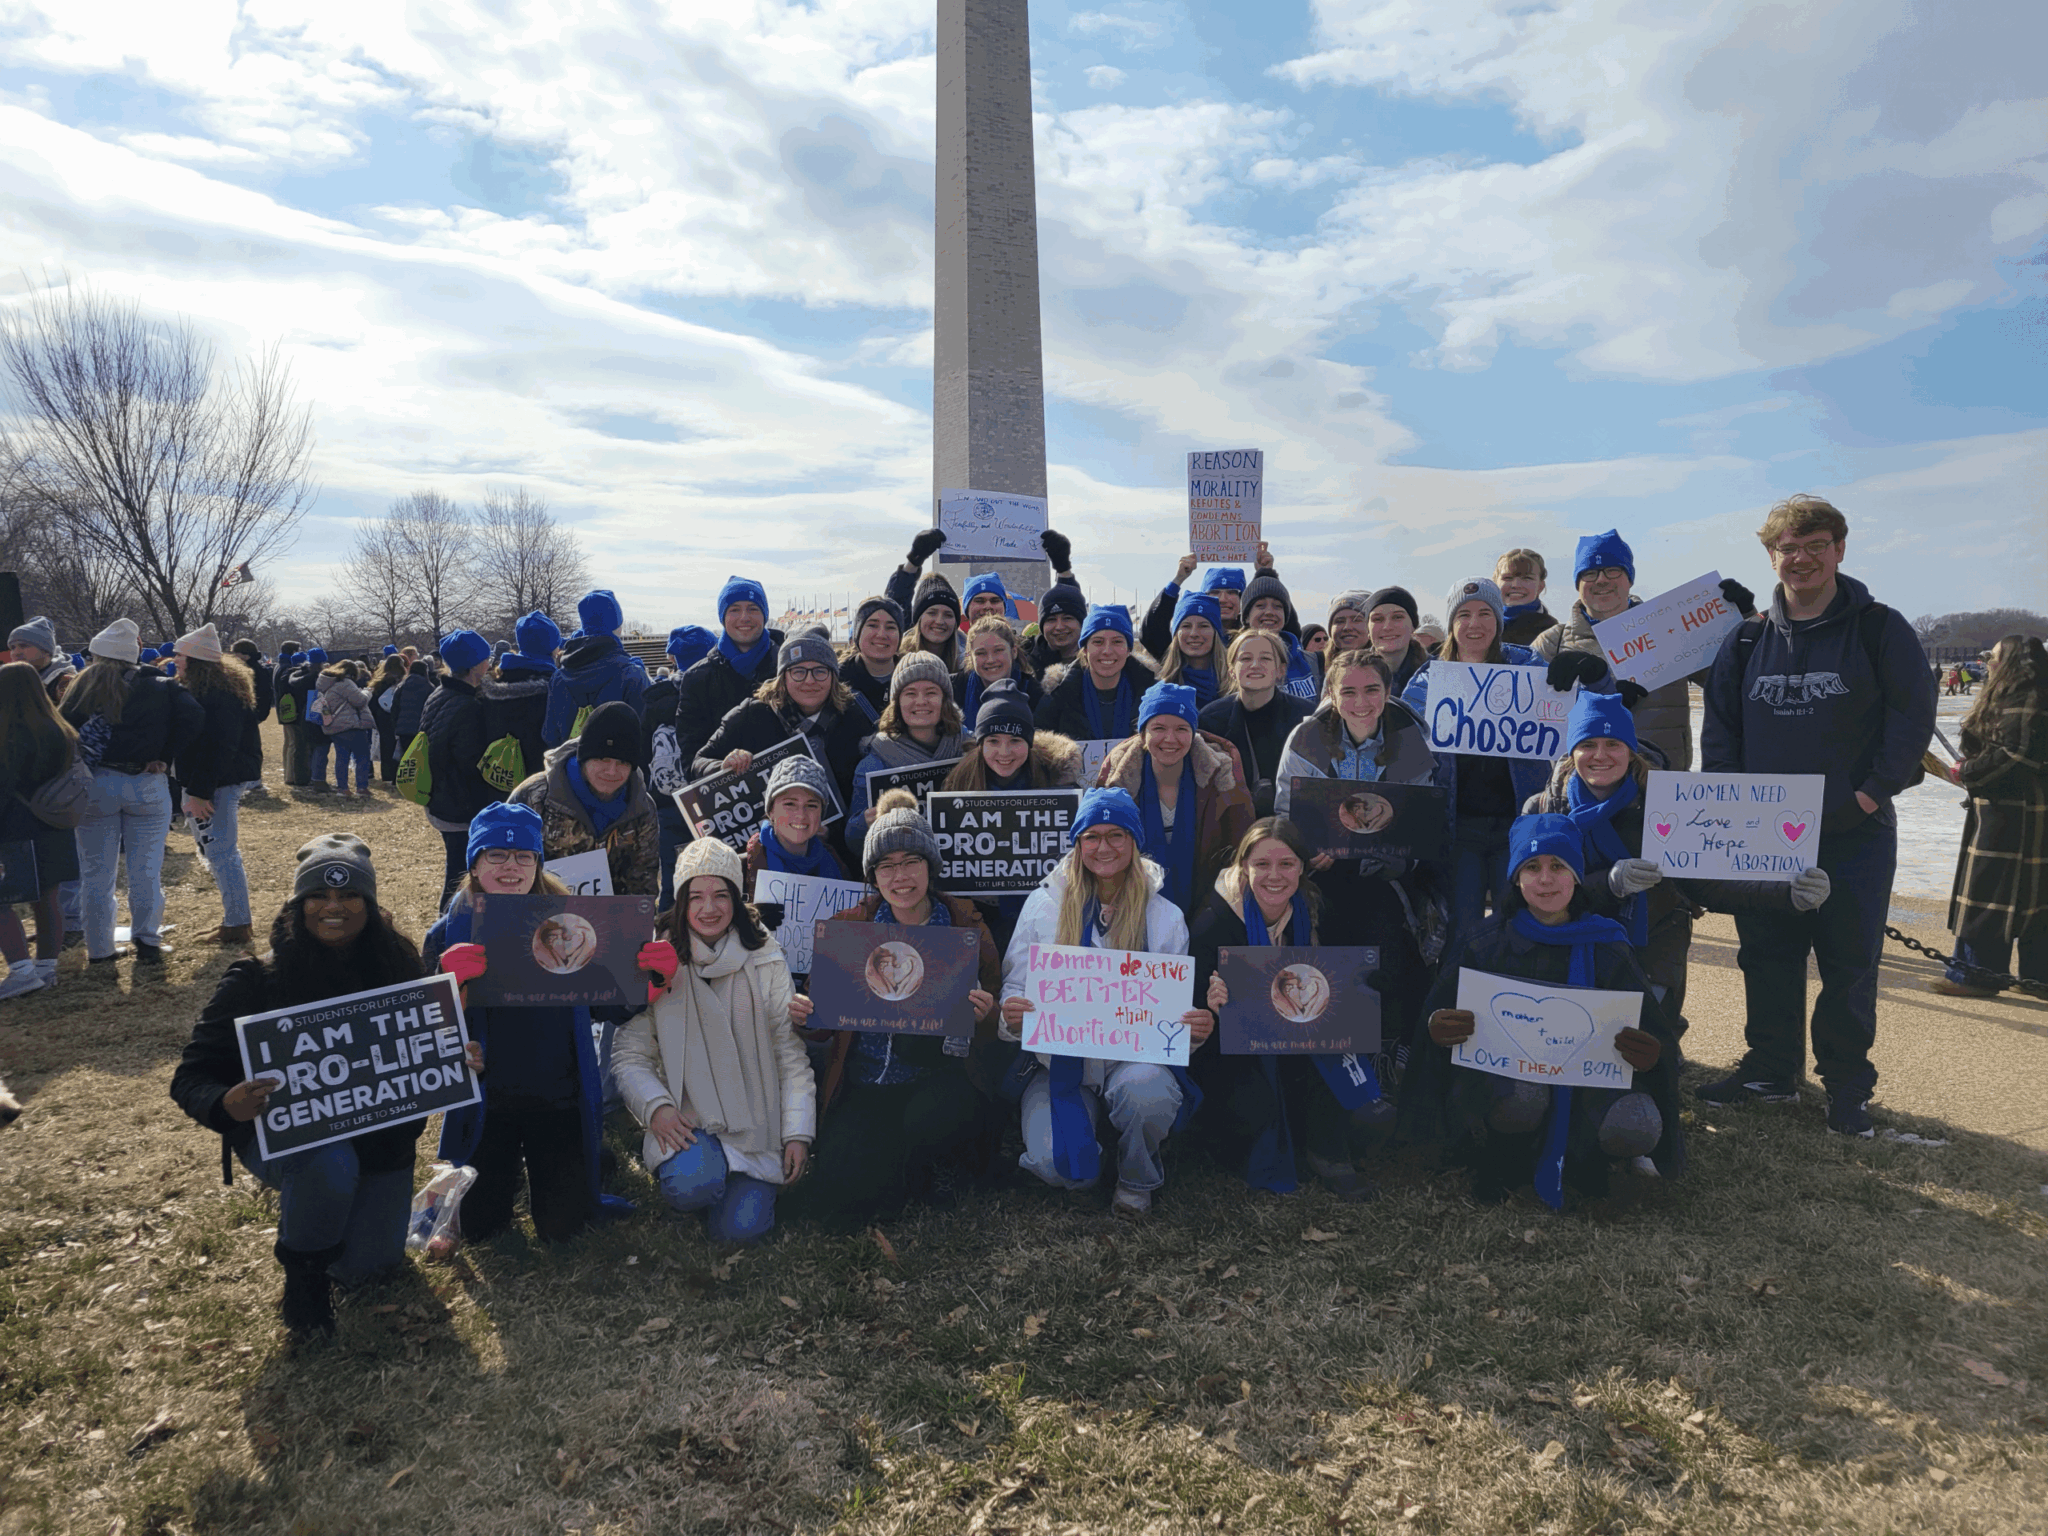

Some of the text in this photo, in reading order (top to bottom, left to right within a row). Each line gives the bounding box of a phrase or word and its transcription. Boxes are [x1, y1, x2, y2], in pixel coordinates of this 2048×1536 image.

[1192, 451, 1258, 470] REASON
[1191, 480, 1259, 498] MORALITY
[1191, 498, 1241, 509] REFUTES &
[1191, 511, 1242, 521] CONDEMNS
[992, 535, 1018, 548] Made
[1191, 523, 1261, 541] ABORTION
[1191, 544, 1211, 553] LOVE
[1200, 553, 1220, 562] EVIL
[1227, 553, 1248, 562] HATE
[1608, 632, 1657, 665] LOVE
[1681, 597, 1728, 632] HOPE
[1642, 661, 1667, 679] not
[1467, 666, 1534, 716] YOU
[1535, 698, 1567, 719] are
[1773, 708, 1795, 716] Isaiah
[1431, 697, 1560, 757] Chosen
[709, 747, 790, 790] STUDENORLIFE.ORG
[692, 779, 751, 817] I AM
[964, 798, 1058, 808] STUDENTSFORLIFE.ORG
[1675, 783, 1787, 803] WOMEN NEED
[939, 811, 946, 829] I
[959, 811, 1002, 828] AM
[1015, 809, 1069, 828] THE
[1686, 808, 1760, 829] Love and
[934, 830, 1073, 856] PRO-LIFE
[1699, 832, 1748, 858] Hope
[938, 858, 1058, 878] GENERATIO
[1662, 851, 1805, 872] NOT ABORTION
[1007, 880, 1016, 888] TO
[769, 879, 807, 923] SHE
[1030, 945, 1189, 982] Women deserve
[1038, 977, 1160, 1006] BETTER
[294, 990, 426, 1027] STUDENTSFORLIFE.ORG
[1115, 1006, 1153, 1026] than
[259, 1001, 445, 1064] I AM THE
[837, 1015, 858, 1027] You
[860, 1017, 878, 1028] are
[880, 1017, 908, 1030] made
[1538, 1027, 1548, 1037] +
[1249, 1039, 1269, 1051] You
[1270, 1040, 1288, 1050] are
[1290, 1038, 1317, 1050] made
[253, 1025, 464, 1096] PRO-LIFE
[1459, 1043, 1624, 1083] LOVE THEM BOTH
[266, 1061, 465, 1132] GENERATION
[329, 1101, 418, 1132] TEXT LIFE TO 53445
